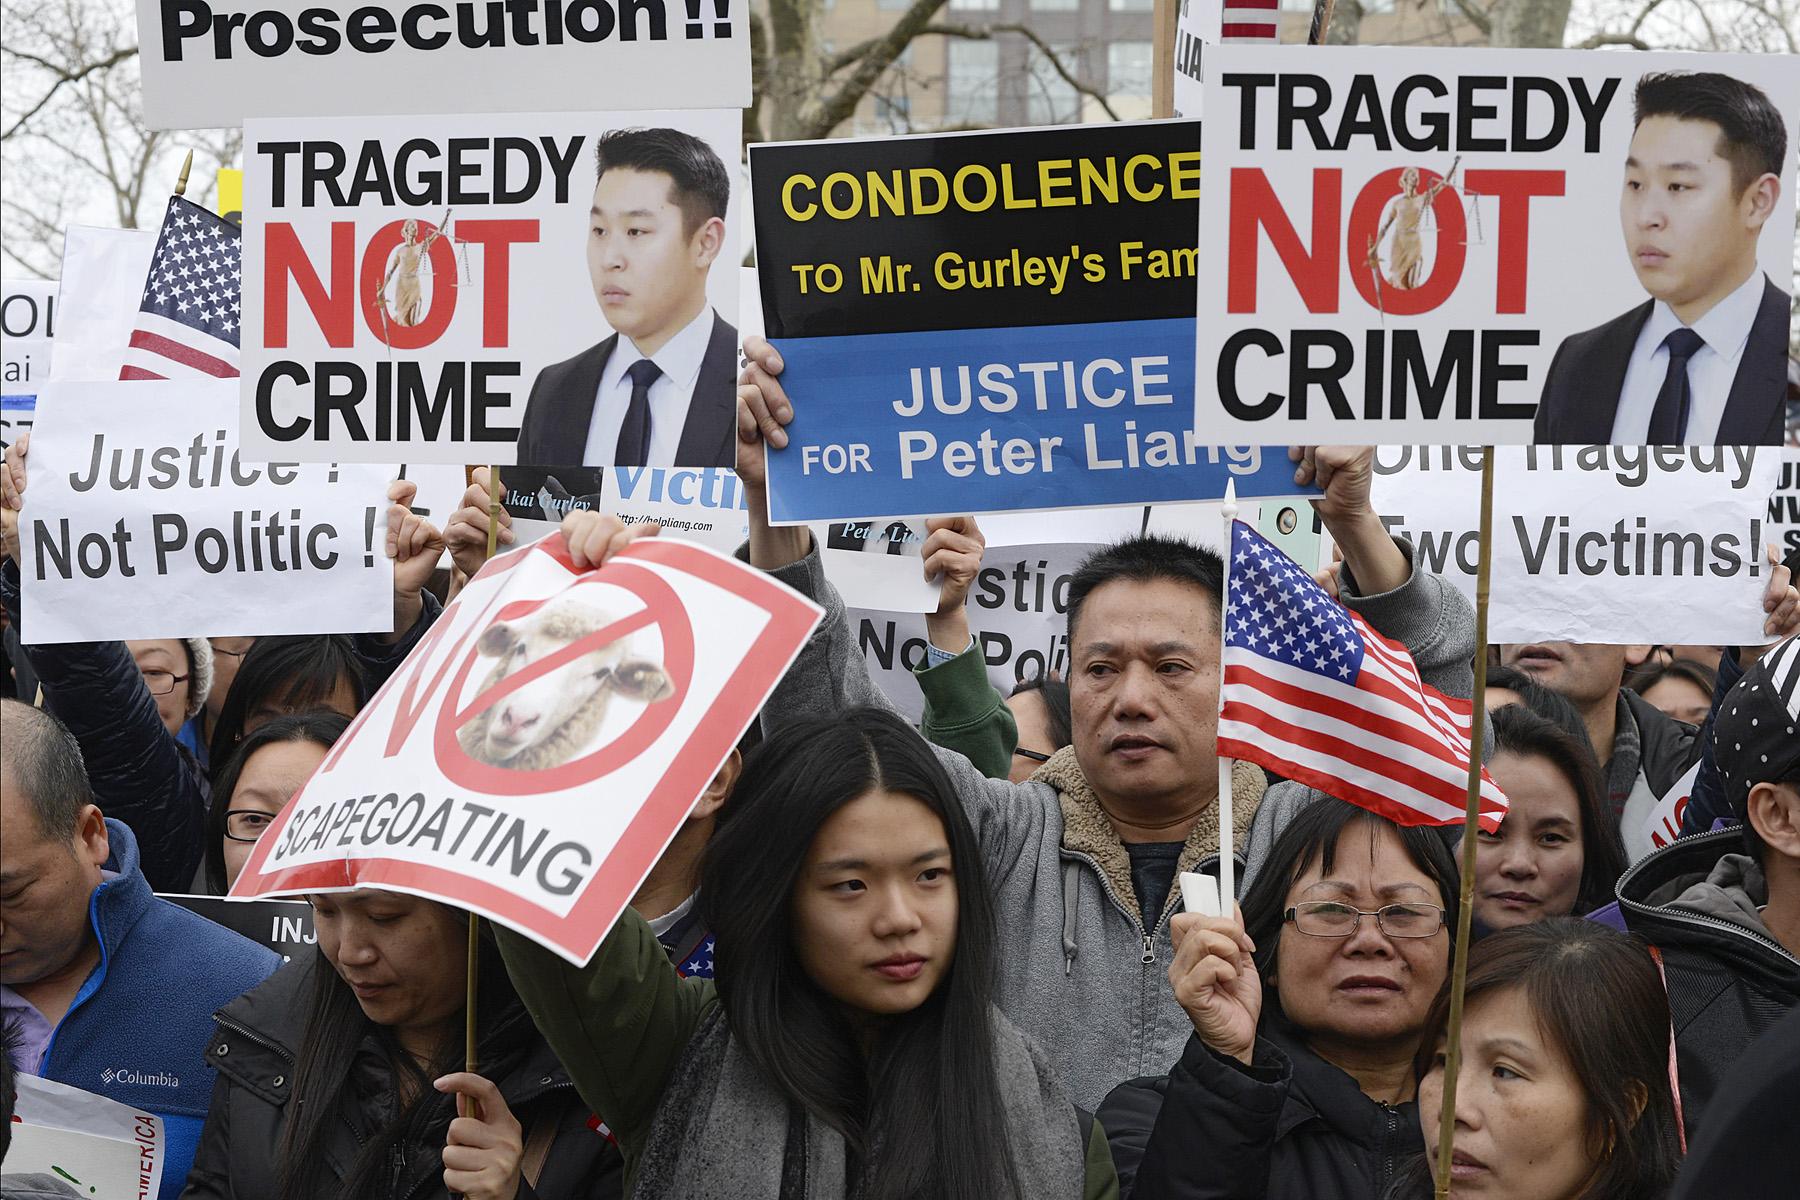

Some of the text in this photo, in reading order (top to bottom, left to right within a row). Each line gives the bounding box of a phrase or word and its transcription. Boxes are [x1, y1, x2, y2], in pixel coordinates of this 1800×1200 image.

[160, 0, 667, 62] Prosecution
[1176, 29, 1204, 83] LIA
[1222, 73, 1621, 154] TRAGEDY
[257, 135, 586, 208] TRAGEDY
[781, 151, 1201, 222] CONDOLENCE
[792, 264, 844, 294] TO
[860, 256, 921, 294] Mr.
[933, 245, 1106, 295] Gurley's
[1227, 166, 1566, 316] NOT
[263, 218, 540, 350] NOT
[256, 361, 521, 442] CRIME
[893, 355, 1174, 418] JUSTICE
[1216, 328, 1540, 422] CRIME
[802, 443, 873, 476] FOR
[899, 428, 1063, 480] Peter
[614, 467, 748, 511] Victi
[616, 512, 713, 532] ttp://helpliang.com
[34, 506, 377, 580] Not Politic !
[1511, 515, 1761, 578] Victims!
[275, 791, 592, 897] SCAPEGOATING
[116, 1069, 179, 1087] Columbia
